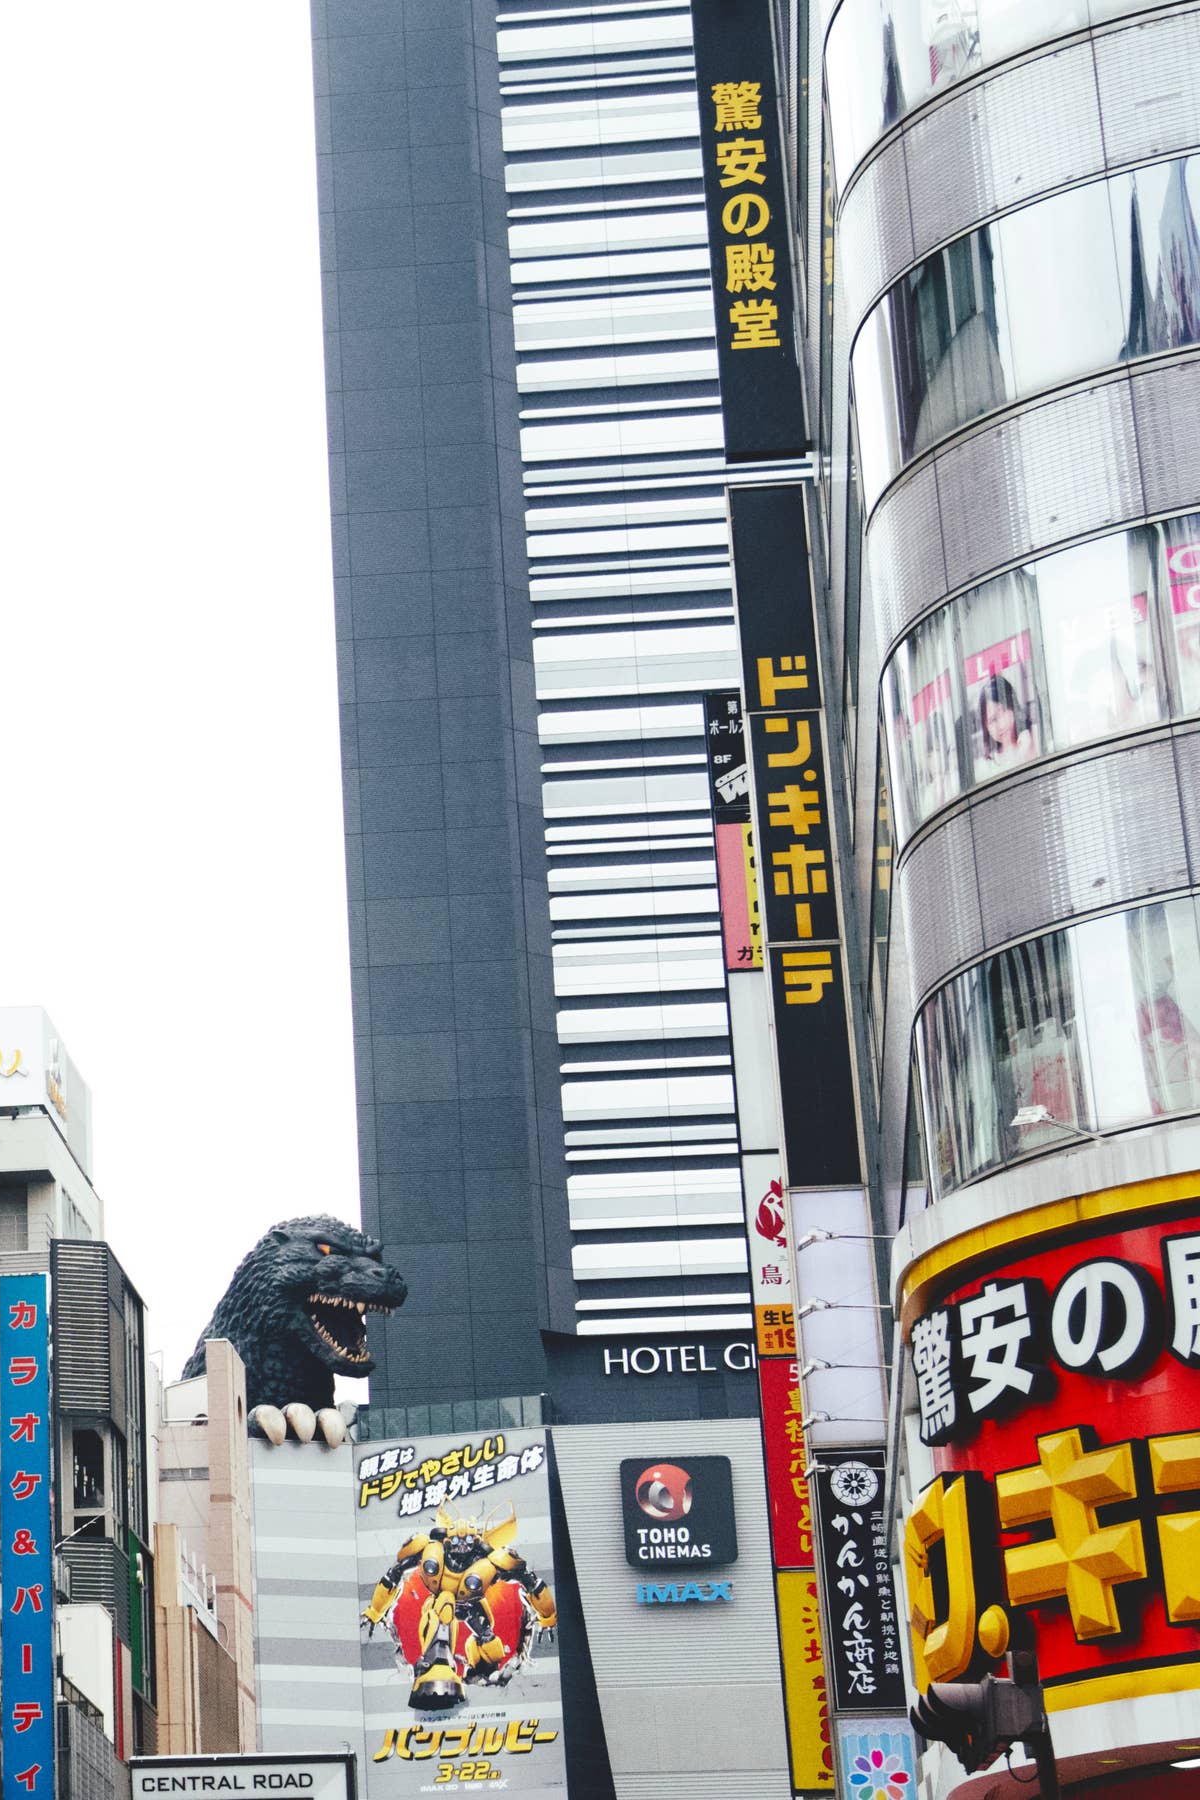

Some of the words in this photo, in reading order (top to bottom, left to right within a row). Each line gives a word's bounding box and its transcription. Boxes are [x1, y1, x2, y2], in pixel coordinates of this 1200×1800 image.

[710, 81, 781, 350] 驚安の殿堂
[713, 754, 732, 764] 8F
[604, 1345, 716, 1375] HOTEL
[360, 1435, 505, 1508] ドジでやさしい
[399, 1446, 545, 1516] 地球外生命体
[637, 1528, 690, 1544] TOHO
[638, 1544, 712, 1560] CINEMAS
[636, 1581, 733, 1603] IMAX
[831, 1512, 877, 1695] かんかん商店
[142, 1775, 246, 1792] CENTRAL
[253, 1773, 314, 1790] ROAD
